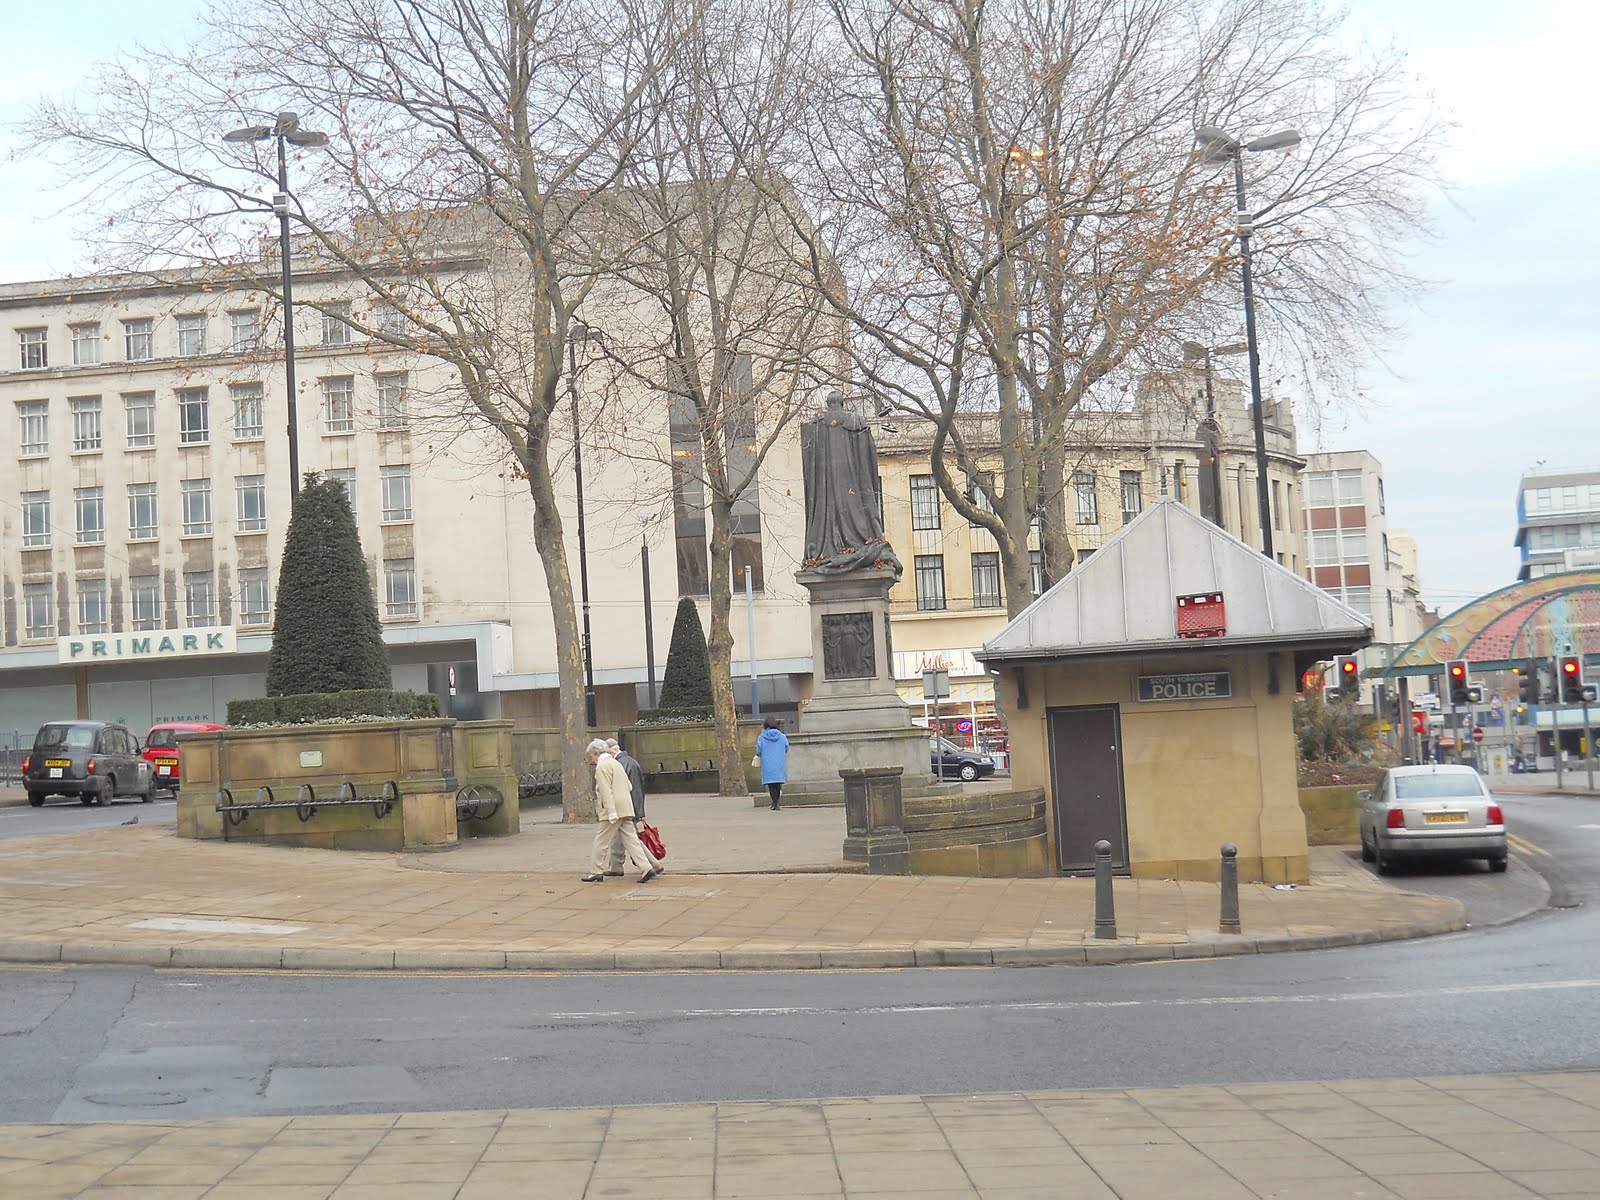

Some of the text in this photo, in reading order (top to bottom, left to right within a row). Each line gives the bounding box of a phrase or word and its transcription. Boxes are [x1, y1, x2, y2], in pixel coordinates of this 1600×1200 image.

[70, 632, 224, 658] PRIMARK
[1151, 674, 1217, 685] SOUTH YORKSHIRE
[1152, 681, 1217, 699] POLICE
[156, 713, 209, 723] PRIMARK
